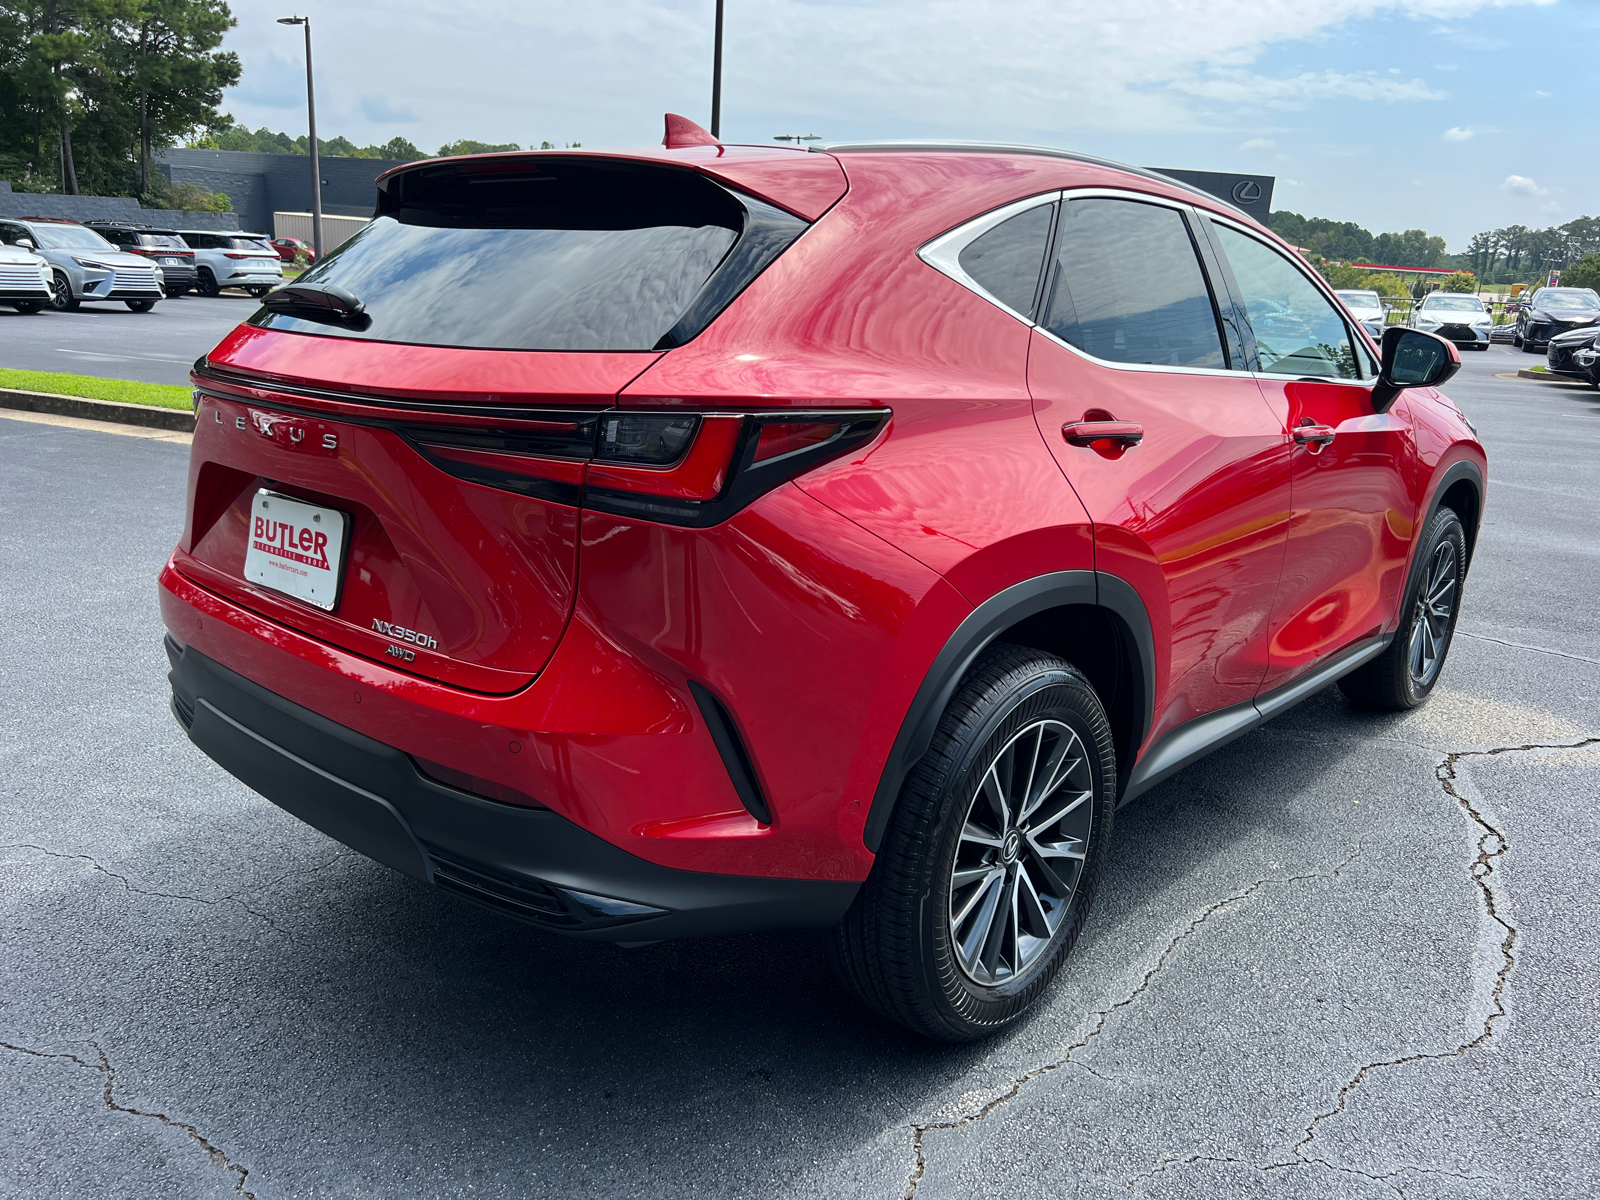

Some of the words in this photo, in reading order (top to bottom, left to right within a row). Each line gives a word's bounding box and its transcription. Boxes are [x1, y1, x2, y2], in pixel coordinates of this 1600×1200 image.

[215, 410, 337, 449] LEXUS
[371, 618, 438, 649] NX350h
[385, 644, 415, 662] AWD
